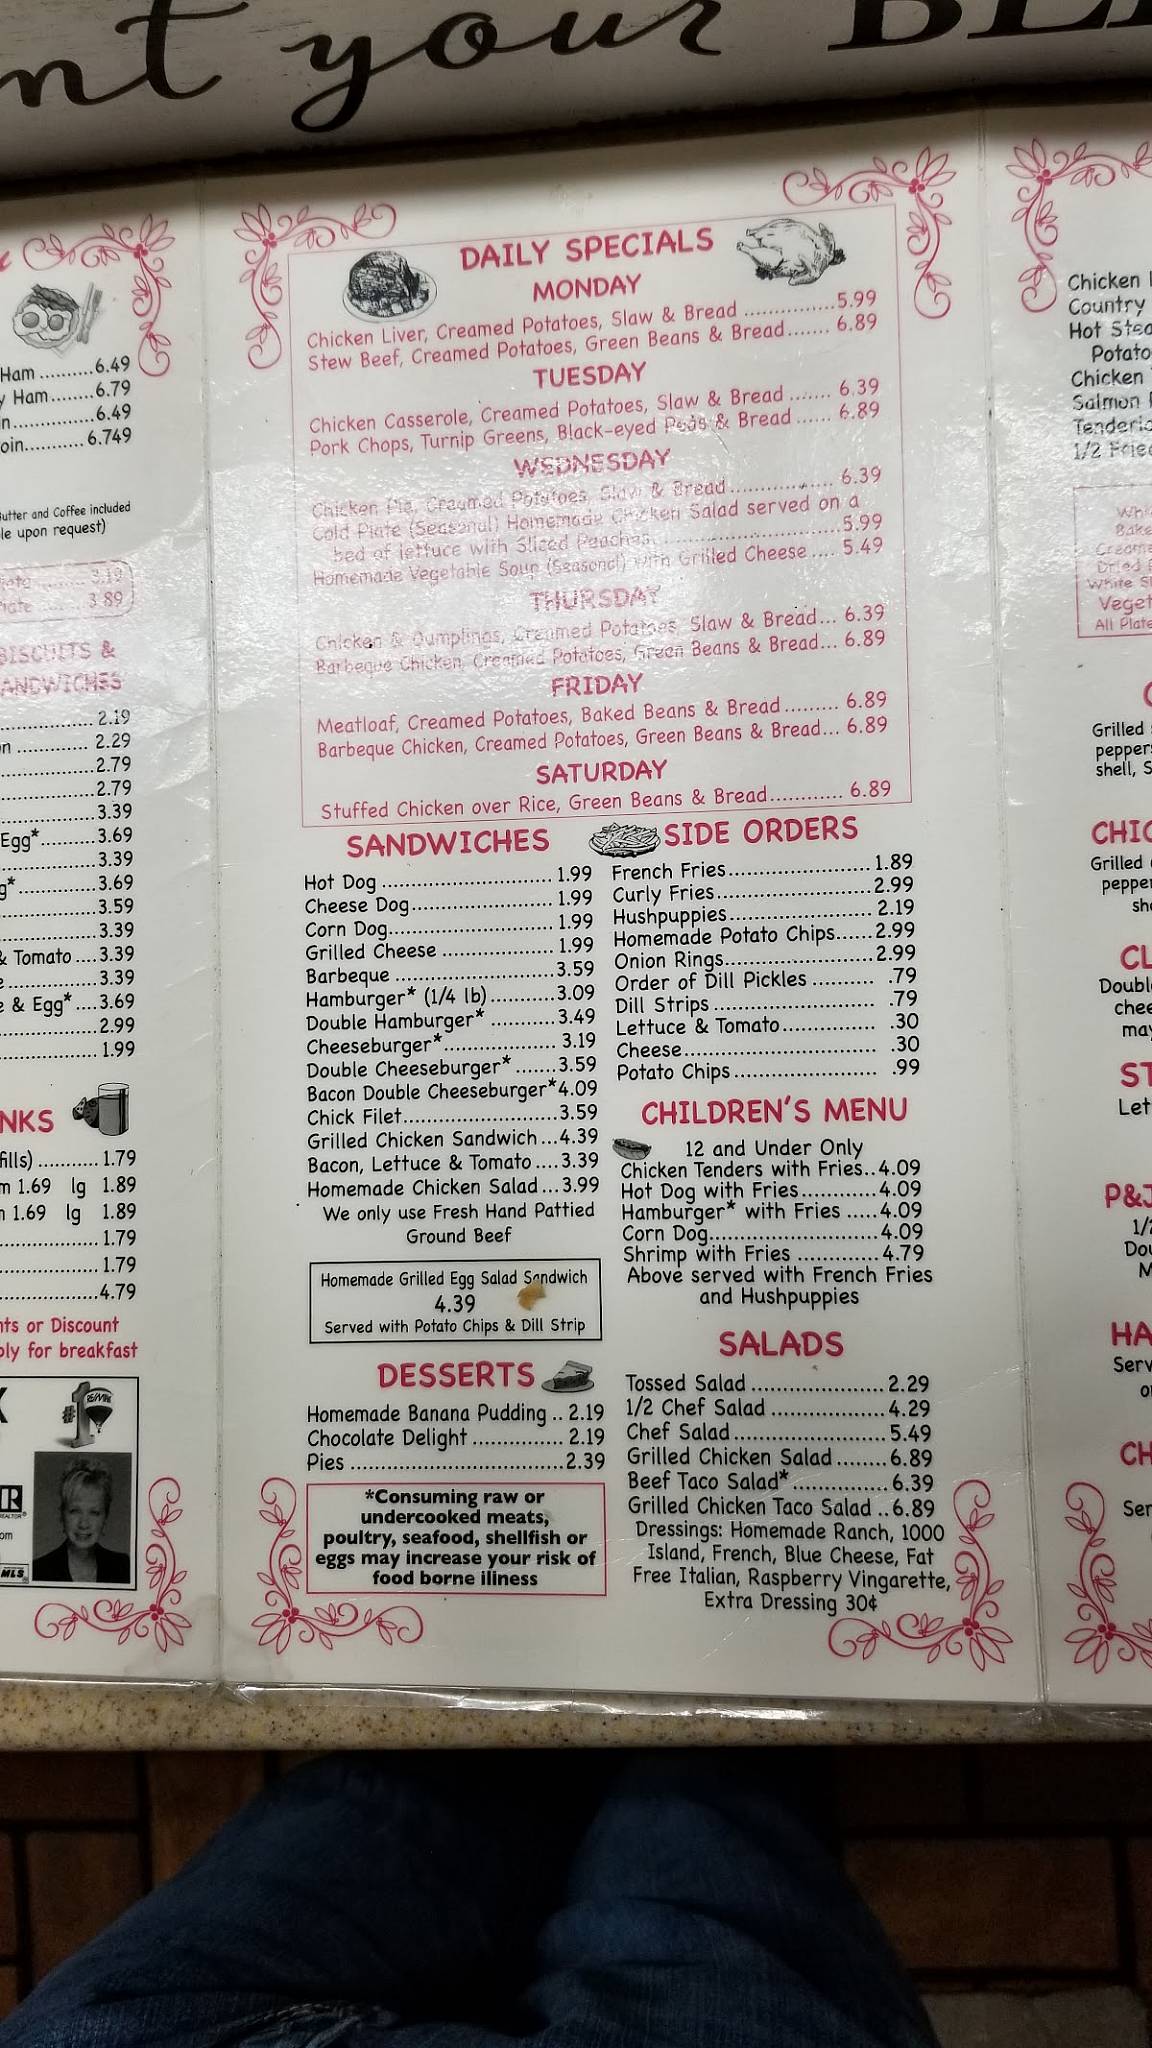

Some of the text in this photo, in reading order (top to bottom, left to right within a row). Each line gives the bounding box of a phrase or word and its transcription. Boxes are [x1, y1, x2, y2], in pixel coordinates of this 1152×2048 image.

[283, 0, 723, 133] your
[460, 227, 714, 271] DAILY SPECIALS
[533, 273, 642, 303] MONDAY
[1068, 272, 1140, 292] Chicken
[1068, 295, 1146, 317] Country
[307, 289, 877, 349] Chicken Liver, Creamed Potatoes, Slaw & Bread 5.99
[309, 313, 878, 372] Stew Beef, Creamed Potatoes, Green Beans & Bread 6.89
[0, 355, 131, 382] Ham 6.49
[533, 361, 647, 389] TUESDAY
[1071, 368, 1144, 388] Chicken
[310, 377, 880, 434] Chicken Casserole, Creamed Potatoes, Slaw & Bread 6.39
[1072, 393, 1140, 413] Salmon
[32, 500, 131, 520] and Coffee included
[551, 672, 644, 698] FRIDAY
[318, 690, 887, 734] Meatloaf, Creamed Potatoes, Baked Beans & Bread 6.89
[1092, 721, 1145, 738] Grilled
[536, 759, 668, 785] SATURDAY
[1096, 761, 1136, 778] shell,
[321, 780, 891, 820] Stuffed Chicken over Rice, Green Beans & Bread 6.89
[98, 827, 133, 844] 3.69
[347, 828, 550, 858] SANDWICHES
[664, 815, 858, 848] SIDE ORDERS
[612, 853, 913, 881] French Fries 1.89
[1091, 854, 1143, 872] Grilled
[305, 865, 592, 895] Hot Dog 1.99
[613, 876, 914, 907] Curly Fries 2.99
[305, 889, 593, 917] Cheese Dog 1.99
[614, 921, 915, 948] Homemade Potato Chips 2.99
[614, 944, 916, 973] Onion Rings 2.99
[424, 986, 456, 1008] (1/4
[465, 985, 487, 1007] lb)
[557, 984, 595, 1001] 3.09
[616, 1012, 919, 1037] Lettuce & Tomato .30
[306, 1061, 368, 1079] Double
[559, 1055, 597, 1073] 3.59
[642, 1095, 908, 1126] CHILDREN'S MENU
[308, 1127, 599, 1150] Grilled Chicken Sandwich 4.39
[686, 1138, 864, 1161] 12 and Under Only
[622, 1222, 924, 1247] Corn Dog 4.09
[623, 1244, 924, 1268] Shrimp with Fries 4.79
[321, 1268, 588, 1291] Homemade Grilled Egg Salad Sandwich
[434, 1294, 476, 1314] 4.39
[26, 1316, 120, 1334] or Discount
[28, 1341, 138, 1359] for breakfast
[720, 1330, 844, 1357] SALADS
[377, 1360, 535, 1389] DESSERTS
[625, 1373, 930, 1393] Tossed Salad 2.29
[307, 1402, 605, 1428] Homemade Banana Pudding 2.19
[307, 1452, 606, 1472] Pies 2.39
[627, 1470, 672, 1491] Beef
[676, 1472, 719, 1491] Taco
[892, 1473, 934, 1493] 6.39
[484, 1492, 519, 1504] raw
[524, 1492, 546, 1504] or
[1, 1568, 25, 1579] MLS
[372, 1570, 414, 1586] food
[420, 1570, 475, 1586] borne
[704, 1590, 753, 1609] Extra
[760, 1592, 837, 1617] Dressing
